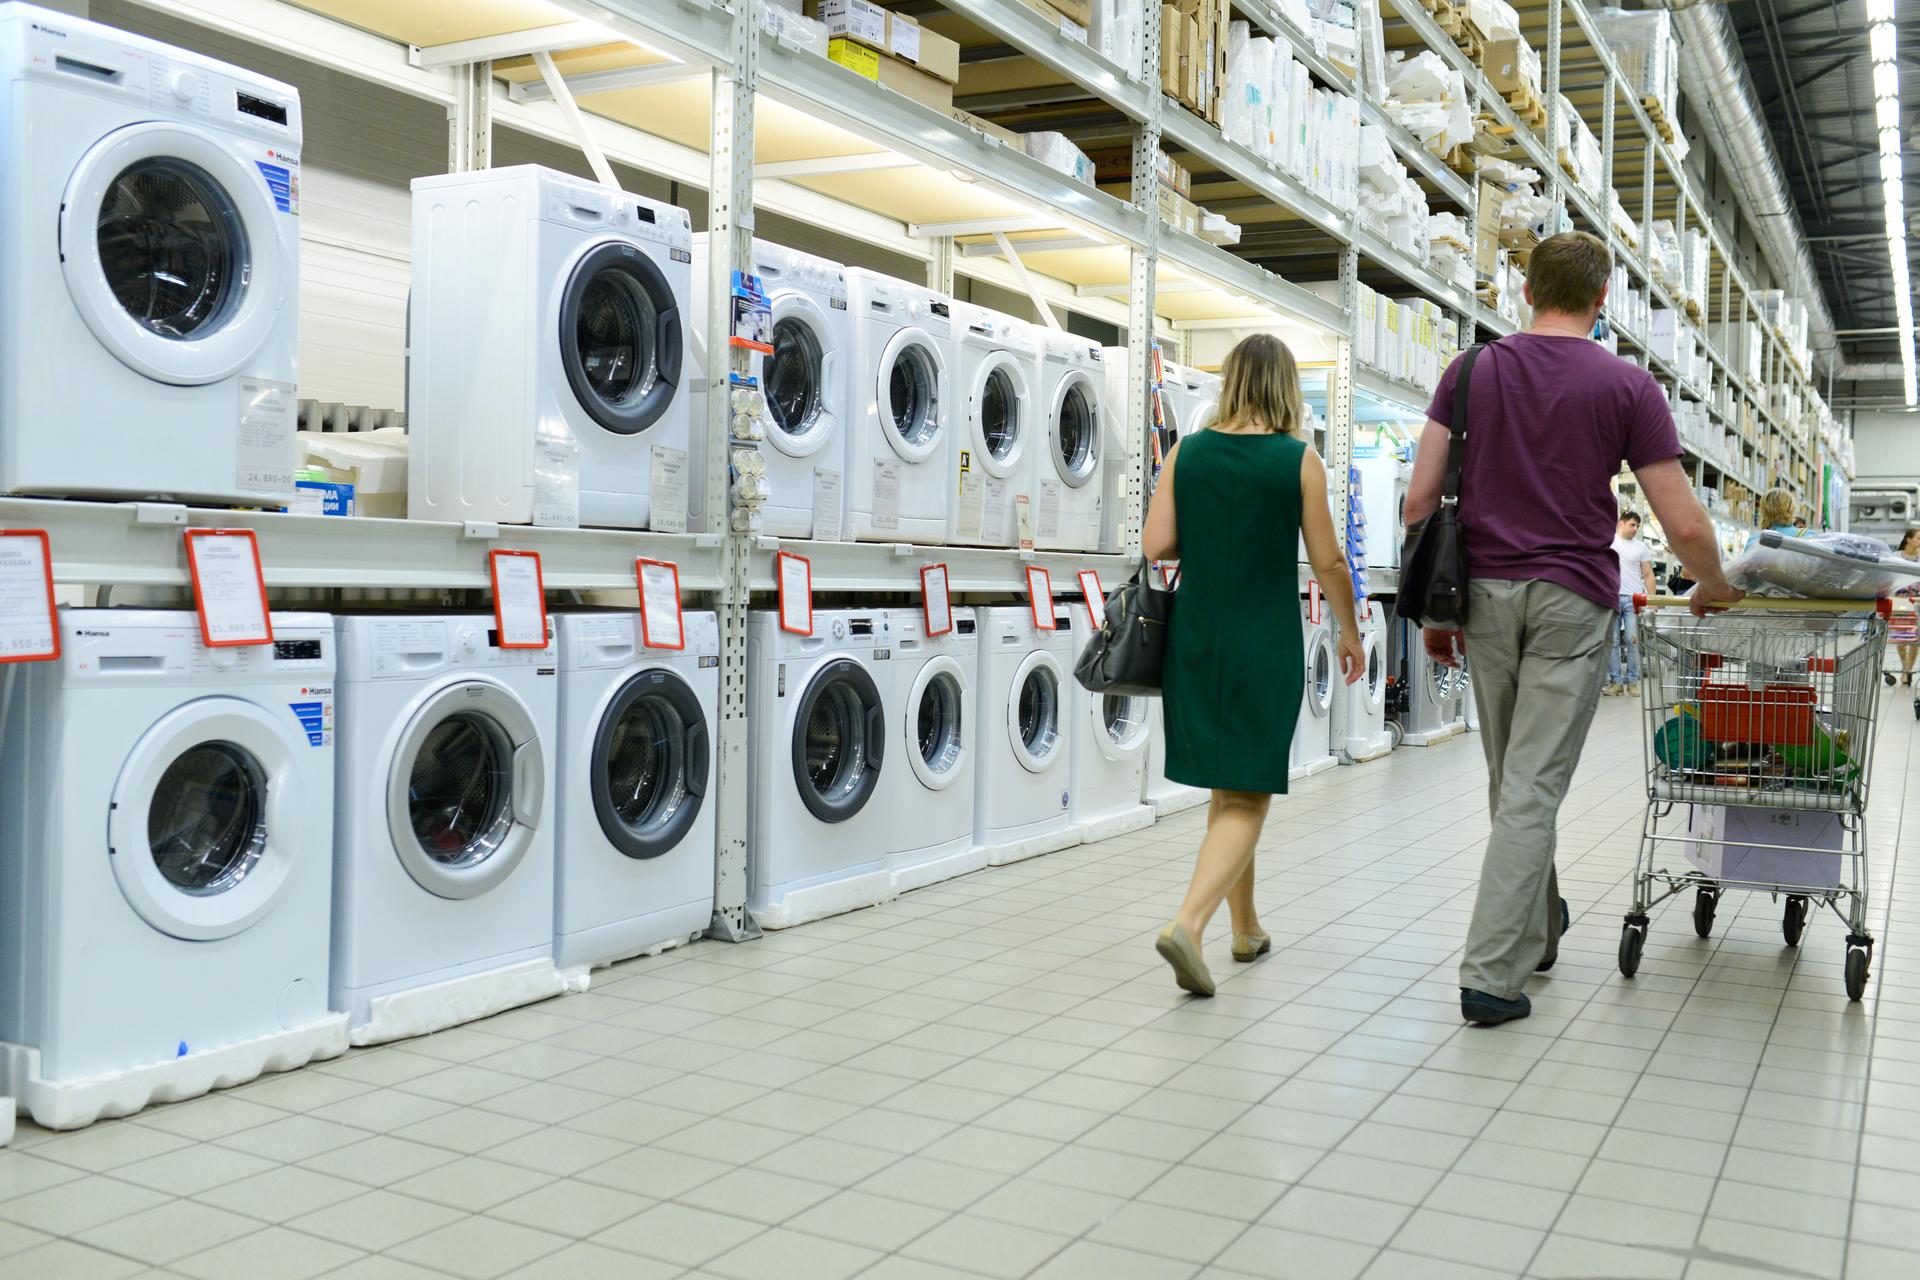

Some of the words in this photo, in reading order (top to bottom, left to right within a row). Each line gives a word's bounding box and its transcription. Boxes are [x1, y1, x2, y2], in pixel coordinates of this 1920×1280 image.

[275, 151, 299, 167] Hansa
[84, 630, 110, 638] Hansa
[308, 687, 332, 695] Hansa
